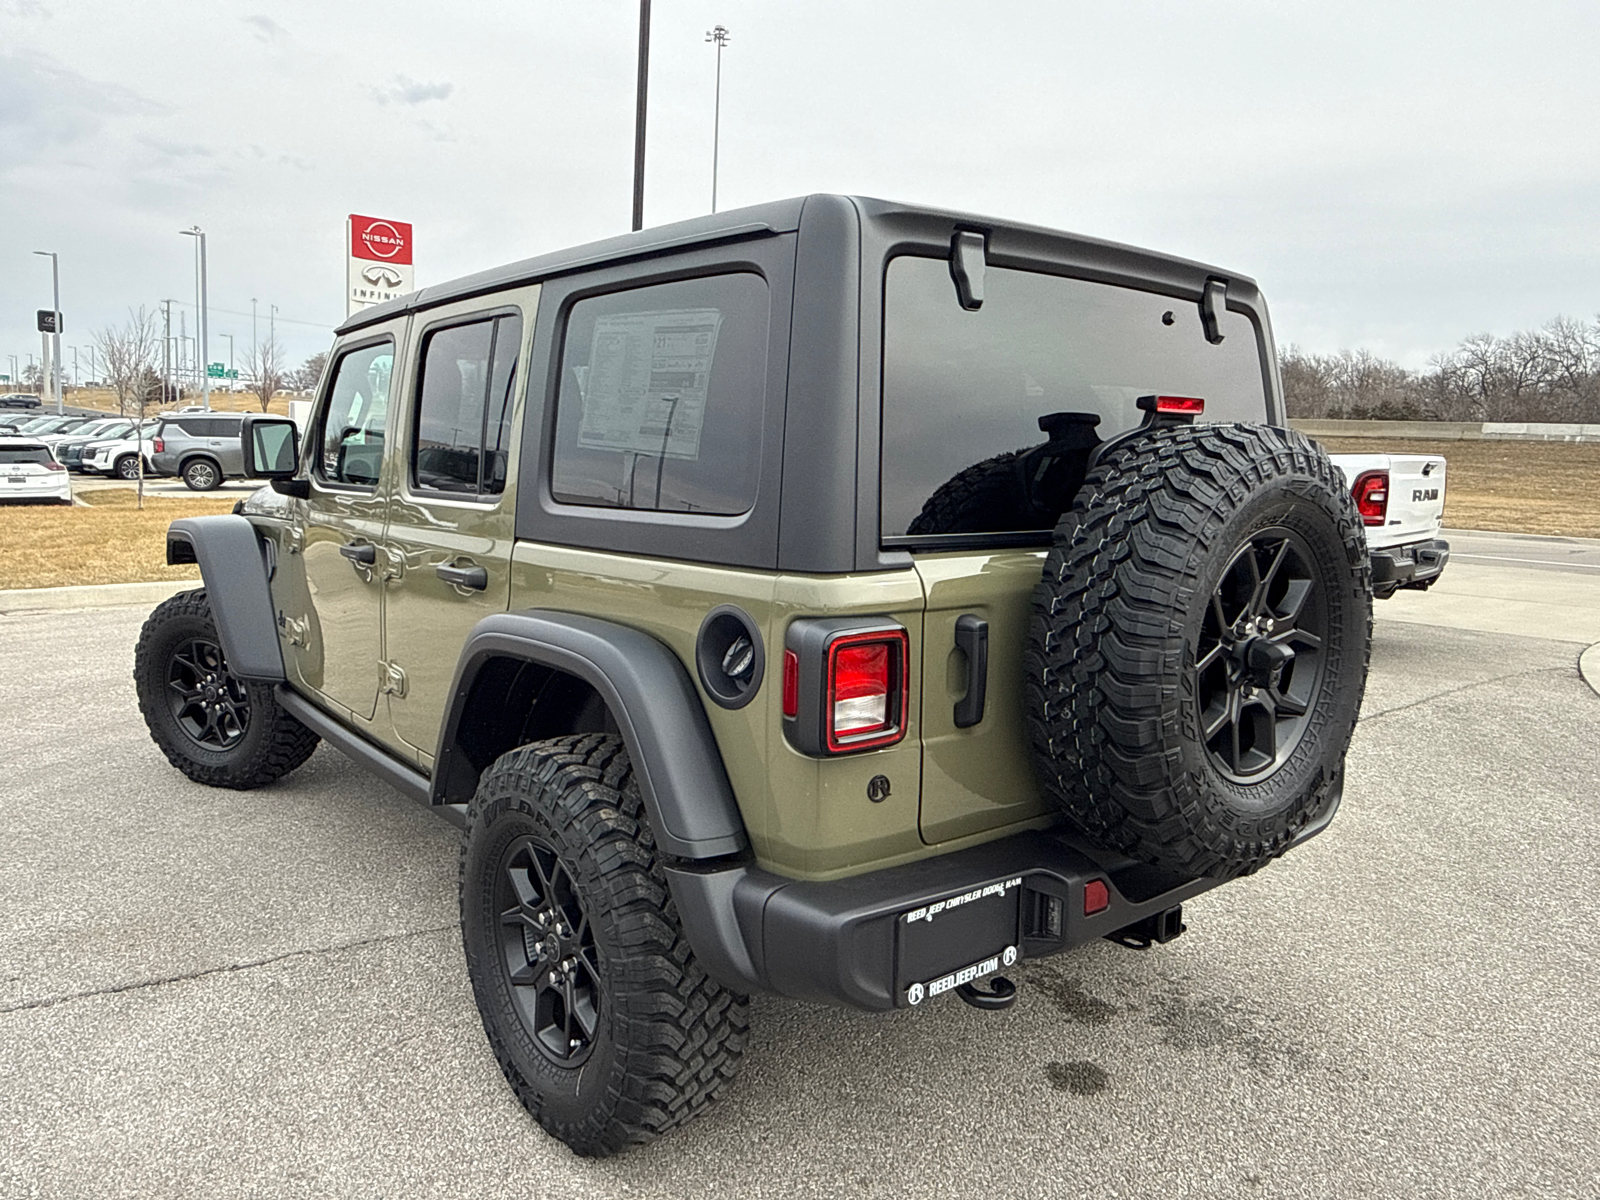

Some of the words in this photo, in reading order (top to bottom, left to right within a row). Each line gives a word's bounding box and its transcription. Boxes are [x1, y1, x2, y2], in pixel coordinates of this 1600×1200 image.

[361, 232, 404, 246] NISSAN
[1412, 488, 1439, 503] RAM
[906, 908, 927, 923] REED
[927, 901, 946, 916] JEEP
[945, 889, 982, 910] CHRYSLER
[929, 957, 999, 998] REEDJEEP.COM
